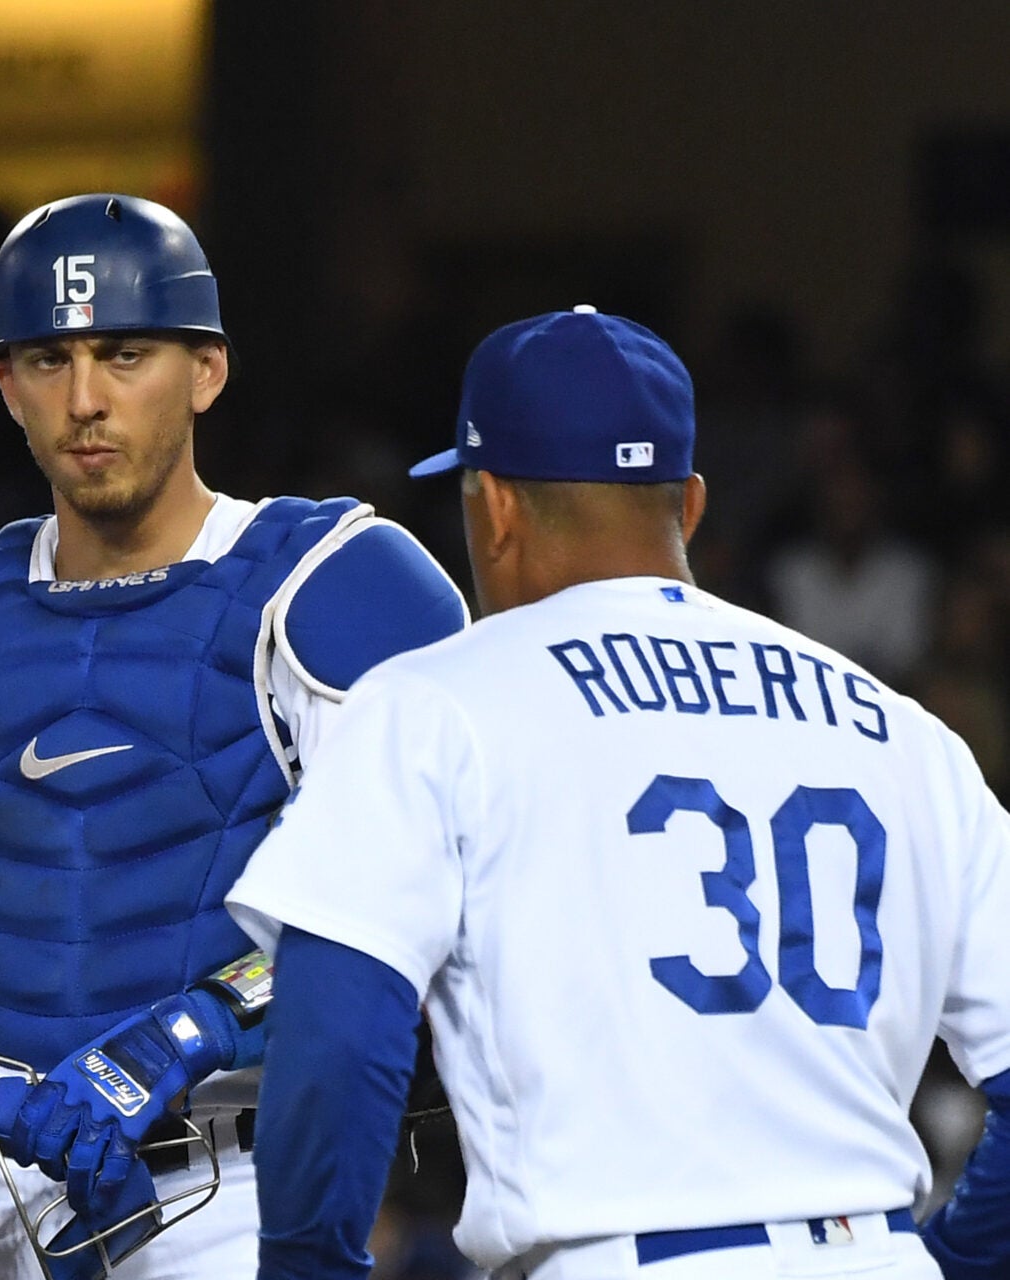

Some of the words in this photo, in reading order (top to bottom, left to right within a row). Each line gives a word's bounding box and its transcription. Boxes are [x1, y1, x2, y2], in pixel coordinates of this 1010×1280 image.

[52, 254, 96, 304] 15
[546, 633, 889, 743] ROBERTS
[626, 774, 887, 1031] 30
[83, 1052, 144, 1104] Franklin
